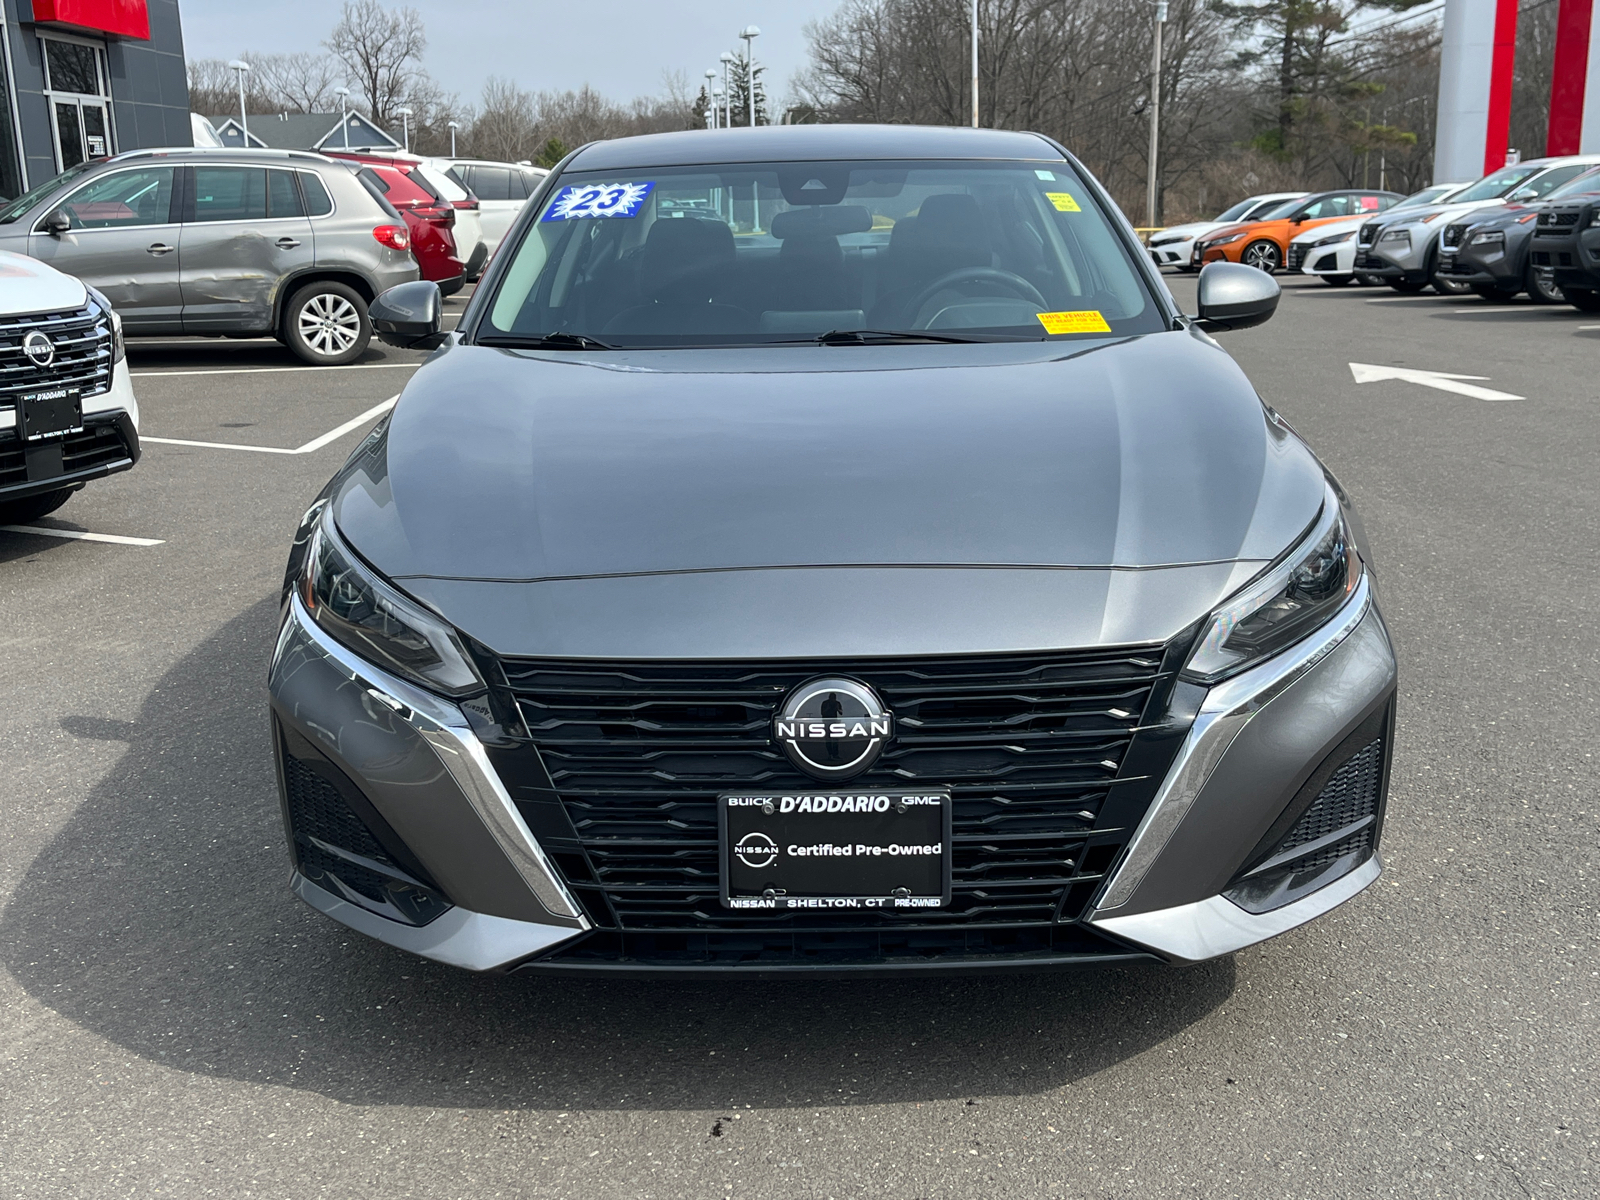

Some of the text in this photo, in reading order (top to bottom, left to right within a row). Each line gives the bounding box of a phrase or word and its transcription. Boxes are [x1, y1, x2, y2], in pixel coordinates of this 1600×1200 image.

[569, 188, 626, 211] 23
[24, 345, 55, 355] NISSAN
[777, 720, 889, 738] NISSAN
[728, 796, 941, 813] BUICK D'ADDARIO GMC
[734, 846, 779, 854] NISSAN
[787, 842, 942, 856] Certified Pre-Owned
[730, 898, 941, 908] NISSAN SHELTON, CT PRE-OWNED
